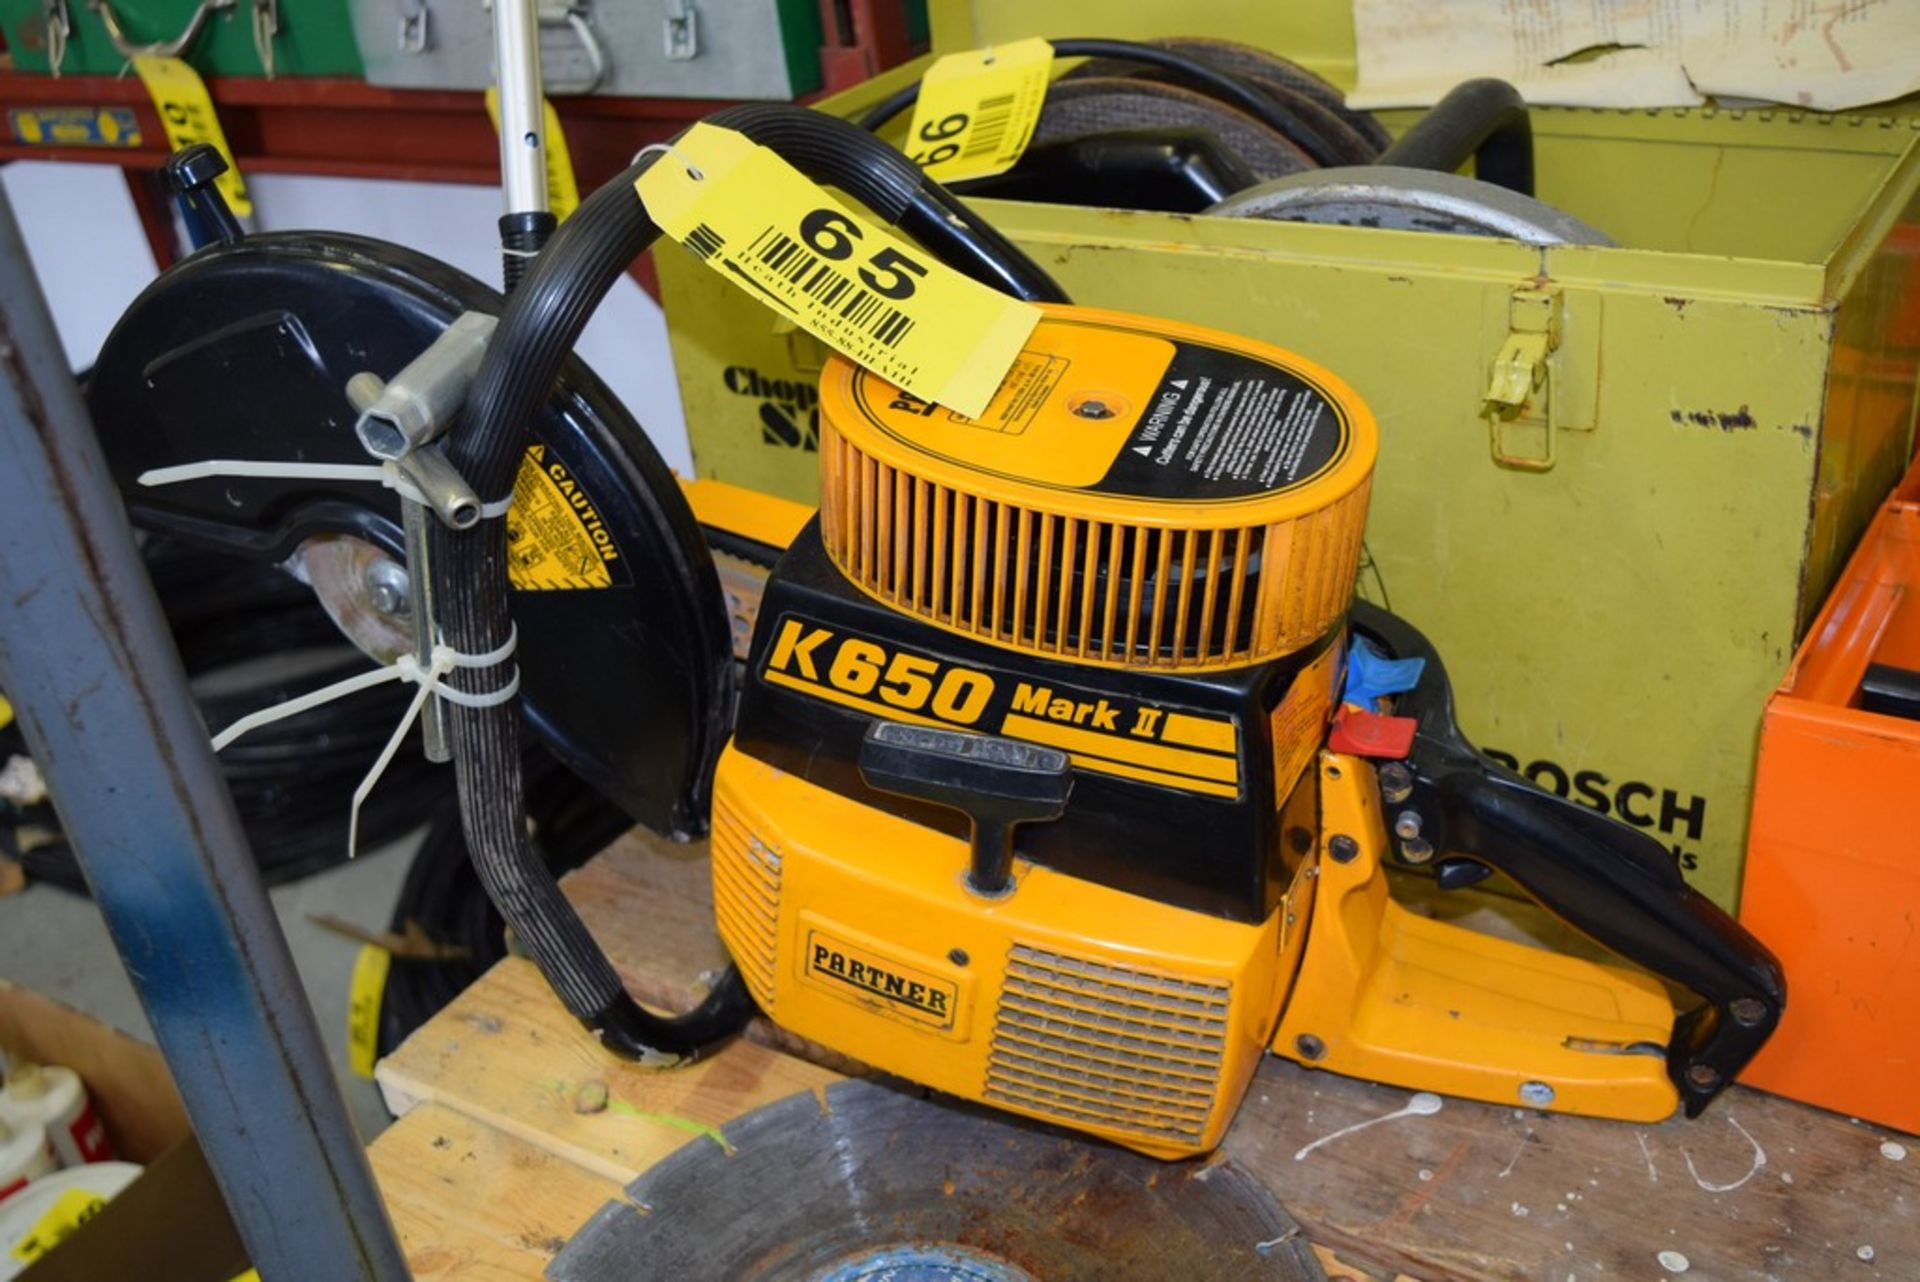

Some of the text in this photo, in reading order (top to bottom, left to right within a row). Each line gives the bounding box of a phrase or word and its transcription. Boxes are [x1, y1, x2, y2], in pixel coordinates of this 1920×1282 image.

[799, 208, 928, 301] 65
[1138, 391, 1182, 442] WARNING
[549, 463, 619, 561] CAUTION
[1010, 682, 1163, 738] Mark II
[813, 944, 948, 1012] PARTNER
